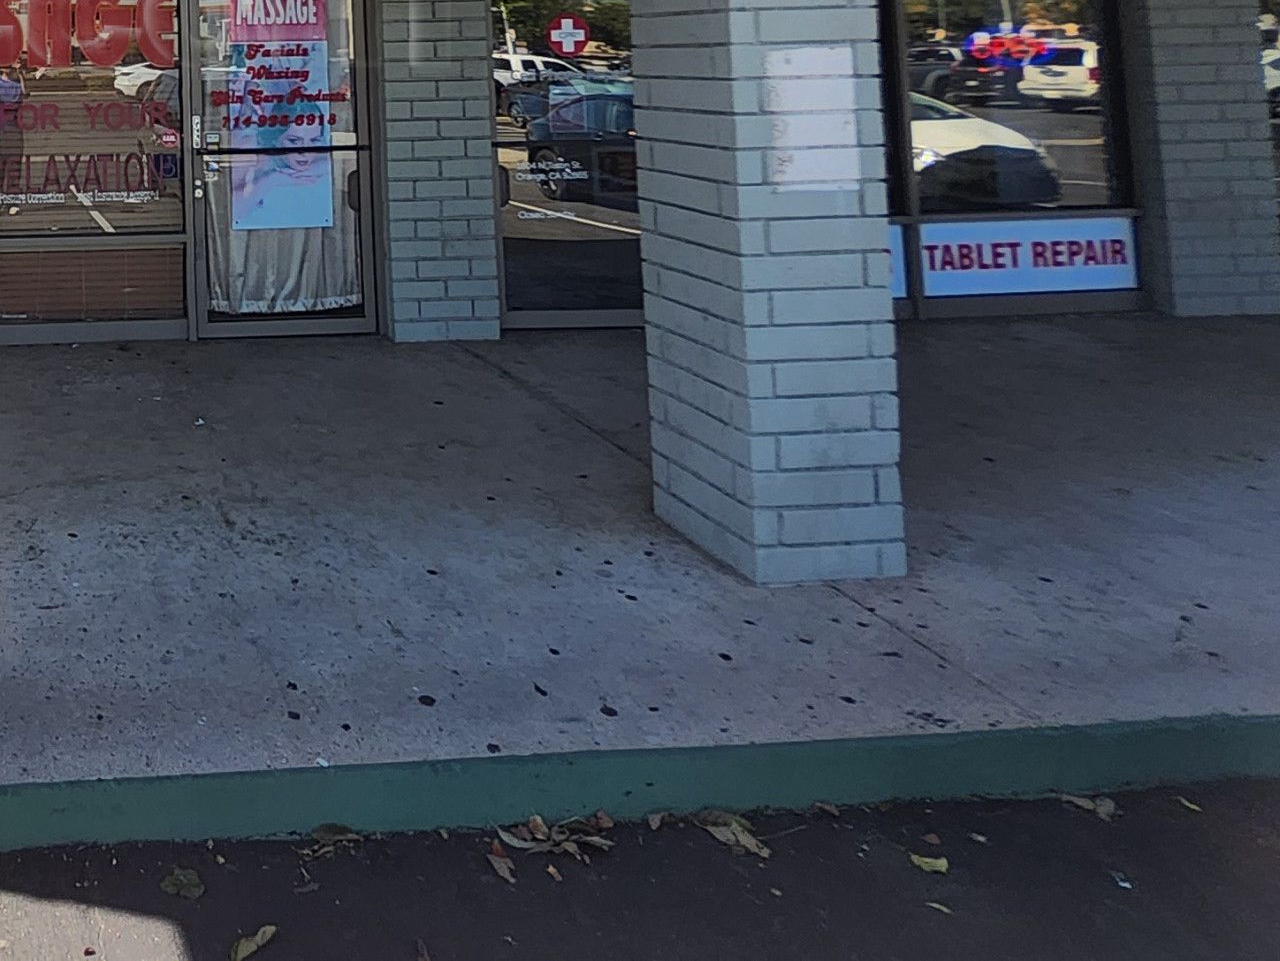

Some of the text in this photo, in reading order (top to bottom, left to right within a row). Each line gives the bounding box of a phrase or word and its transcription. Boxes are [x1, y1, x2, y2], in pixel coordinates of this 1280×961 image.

[245, 43, 309, 60] Facials
[246, 64, 310, 82] Waxing
[248, 89, 284, 105] Care
[287, 86, 348, 105] Products
[84, 100, 170, 130] YOUR
[922, 238, 1129, 272] TABLET REPAIR
